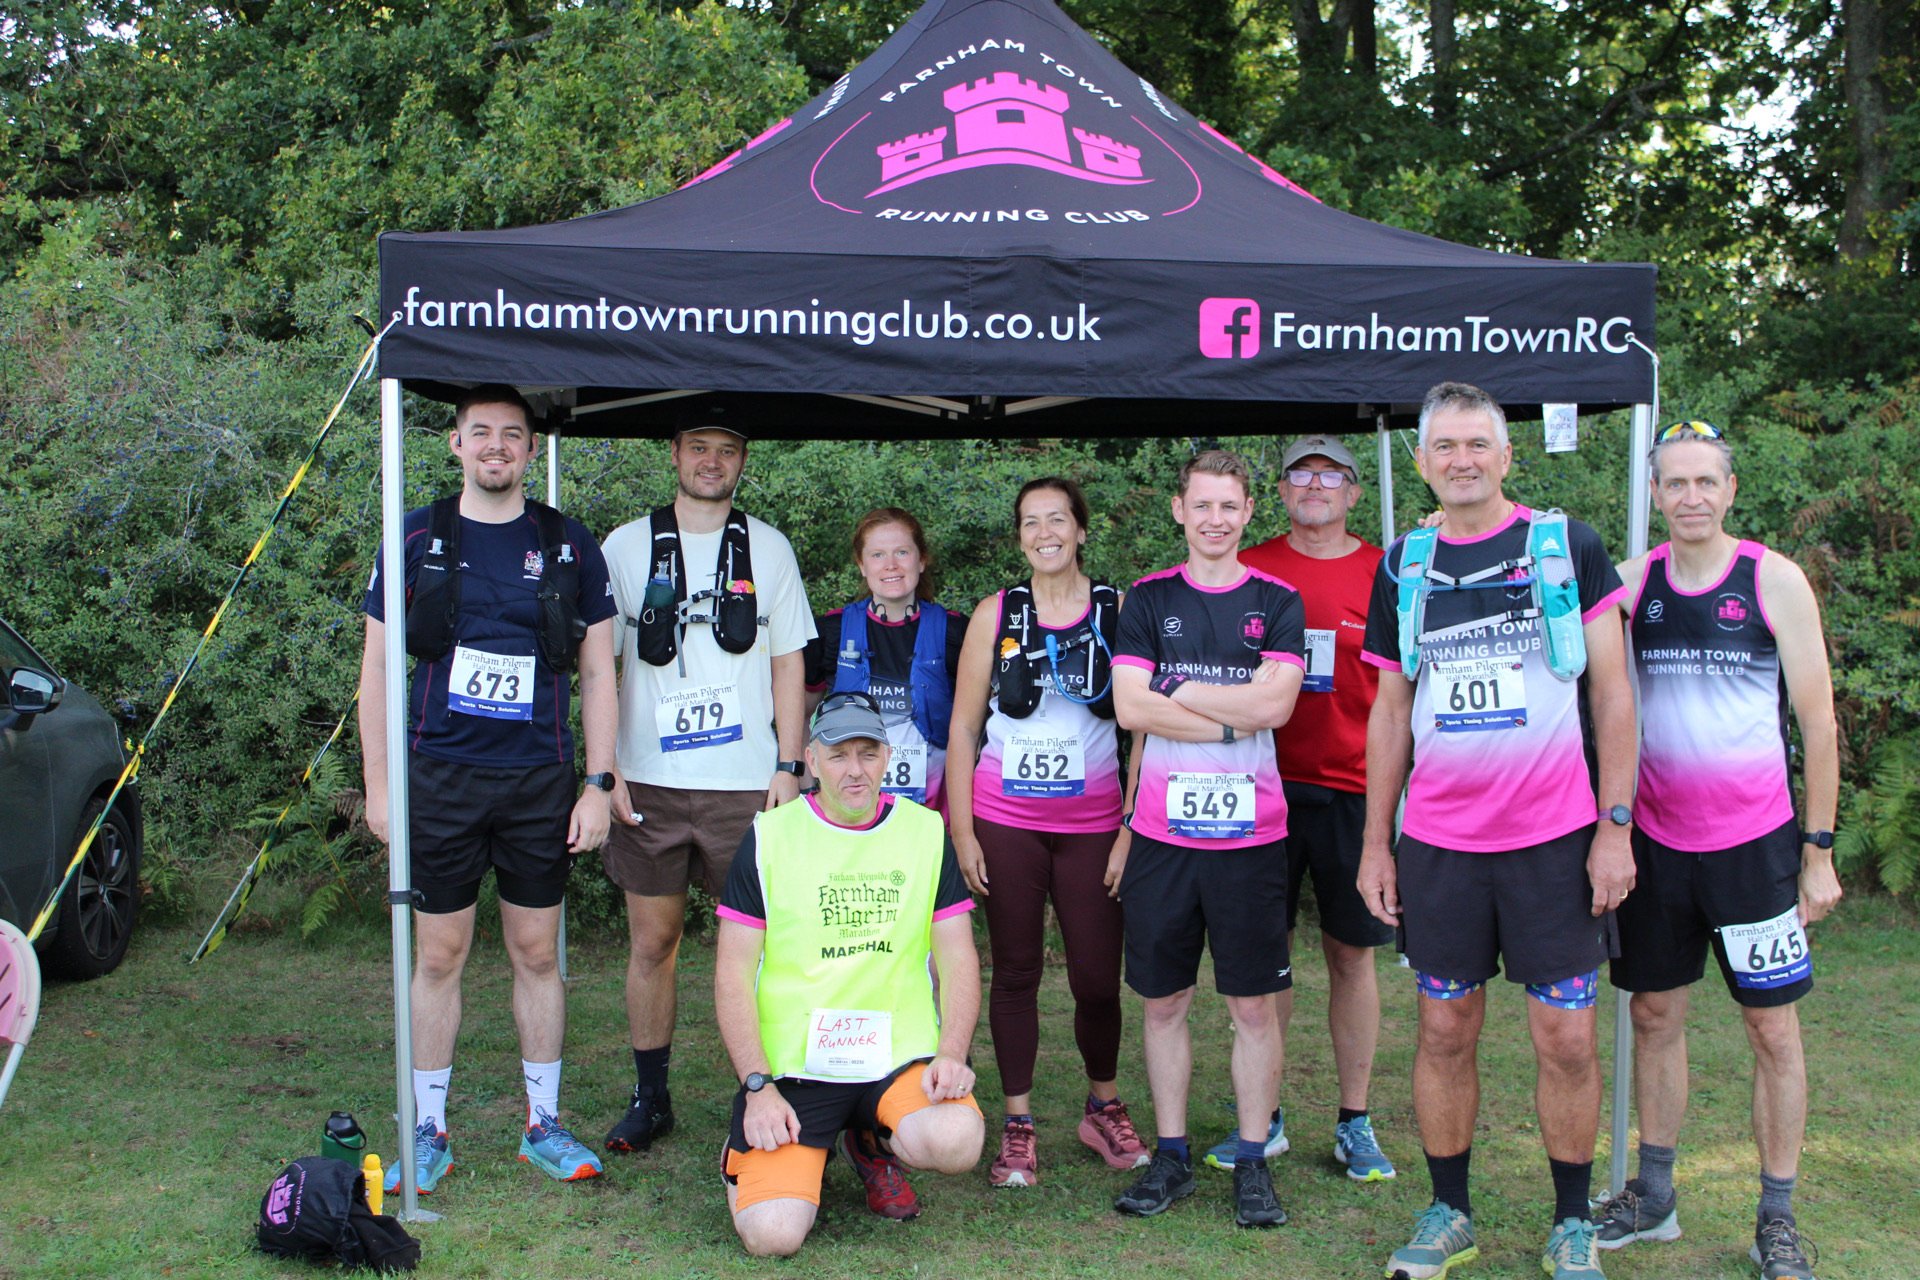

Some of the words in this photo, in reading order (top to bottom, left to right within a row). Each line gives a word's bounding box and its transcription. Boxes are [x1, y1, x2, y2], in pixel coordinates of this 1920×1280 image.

[880, 39, 1025, 103] FARNHAM
[1040, 52, 1122, 108] TOWN
[875, 208, 1050, 223] RUNNING
[1064, 209, 1150, 224] CLUB
[403, 286, 1101, 345] farnhamtownrunningclub.co.uk
[1273, 312, 1632, 354] FarnhamTownRC
[461, 650, 499, 666] Farnham
[502, 656, 532, 670] Pilgrim
[1422, 645, 1490, 662] UNNING
[1494, 636, 1542, 655] CLUB
[1641, 648, 1701, 661] FARNHAM
[1704, 649, 1751, 663] TOWN
[1160, 662, 1222, 677] FARNHAM
[1437, 663, 1473, 675] arnham
[1476, 659, 1513, 673] Pilgrim
[1647, 664, 1702, 675] RUNNING
[1705, 664, 1745, 676] CLUB
[466, 670, 520, 702] 673
[700, 684, 732, 699] Pilgrim
[1449, 679, 1501, 712] 601
[675, 702, 724, 733] 679
[1011, 736, 1045, 747] Farnham
[1047, 737, 1078, 750] Pilgrim
[882, 761, 911, 787] 48
[1017, 753, 1069, 780] 652
[1215, 774, 1248, 787] Pilgrim
[1182, 791, 1238, 819] 549
[818, 883, 900, 907] Farnham
[821, 904, 898, 928] Pilgrim
[1730, 925, 1774, 937] Farnham
[821, 940, 894, 959] MARSHAL
[1747, 931, 1803, 971] 645
[817, 1015, 870, 1032] LAST
